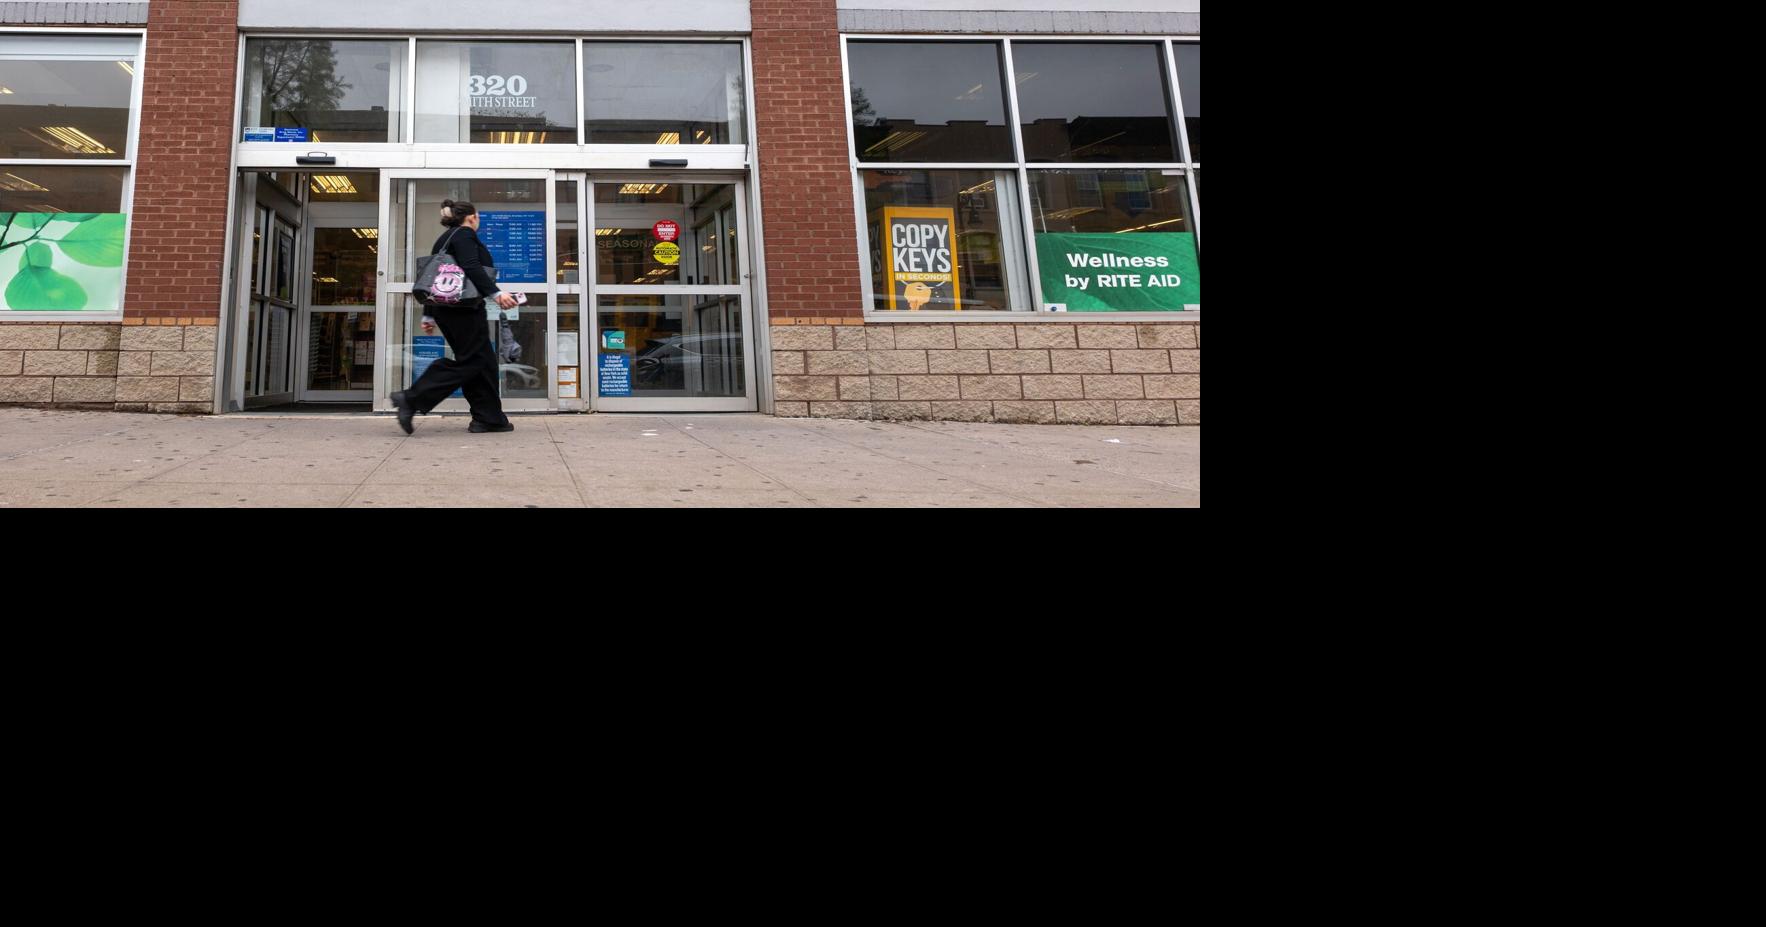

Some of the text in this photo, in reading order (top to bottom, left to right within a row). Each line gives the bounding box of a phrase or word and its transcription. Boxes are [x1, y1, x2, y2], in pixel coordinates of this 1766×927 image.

[468, 74, 528, 96] 320
[467, 96, 537, 108] ITH STREET
[891, 223, 948, 248] COPY
[597, 239, 655, 249] SEASONA
[892, 247, 952, 273] KEYS
[1066, 253, 1169, 268] Wellness
[1064, 274, 1181, 290] by RITE AID
